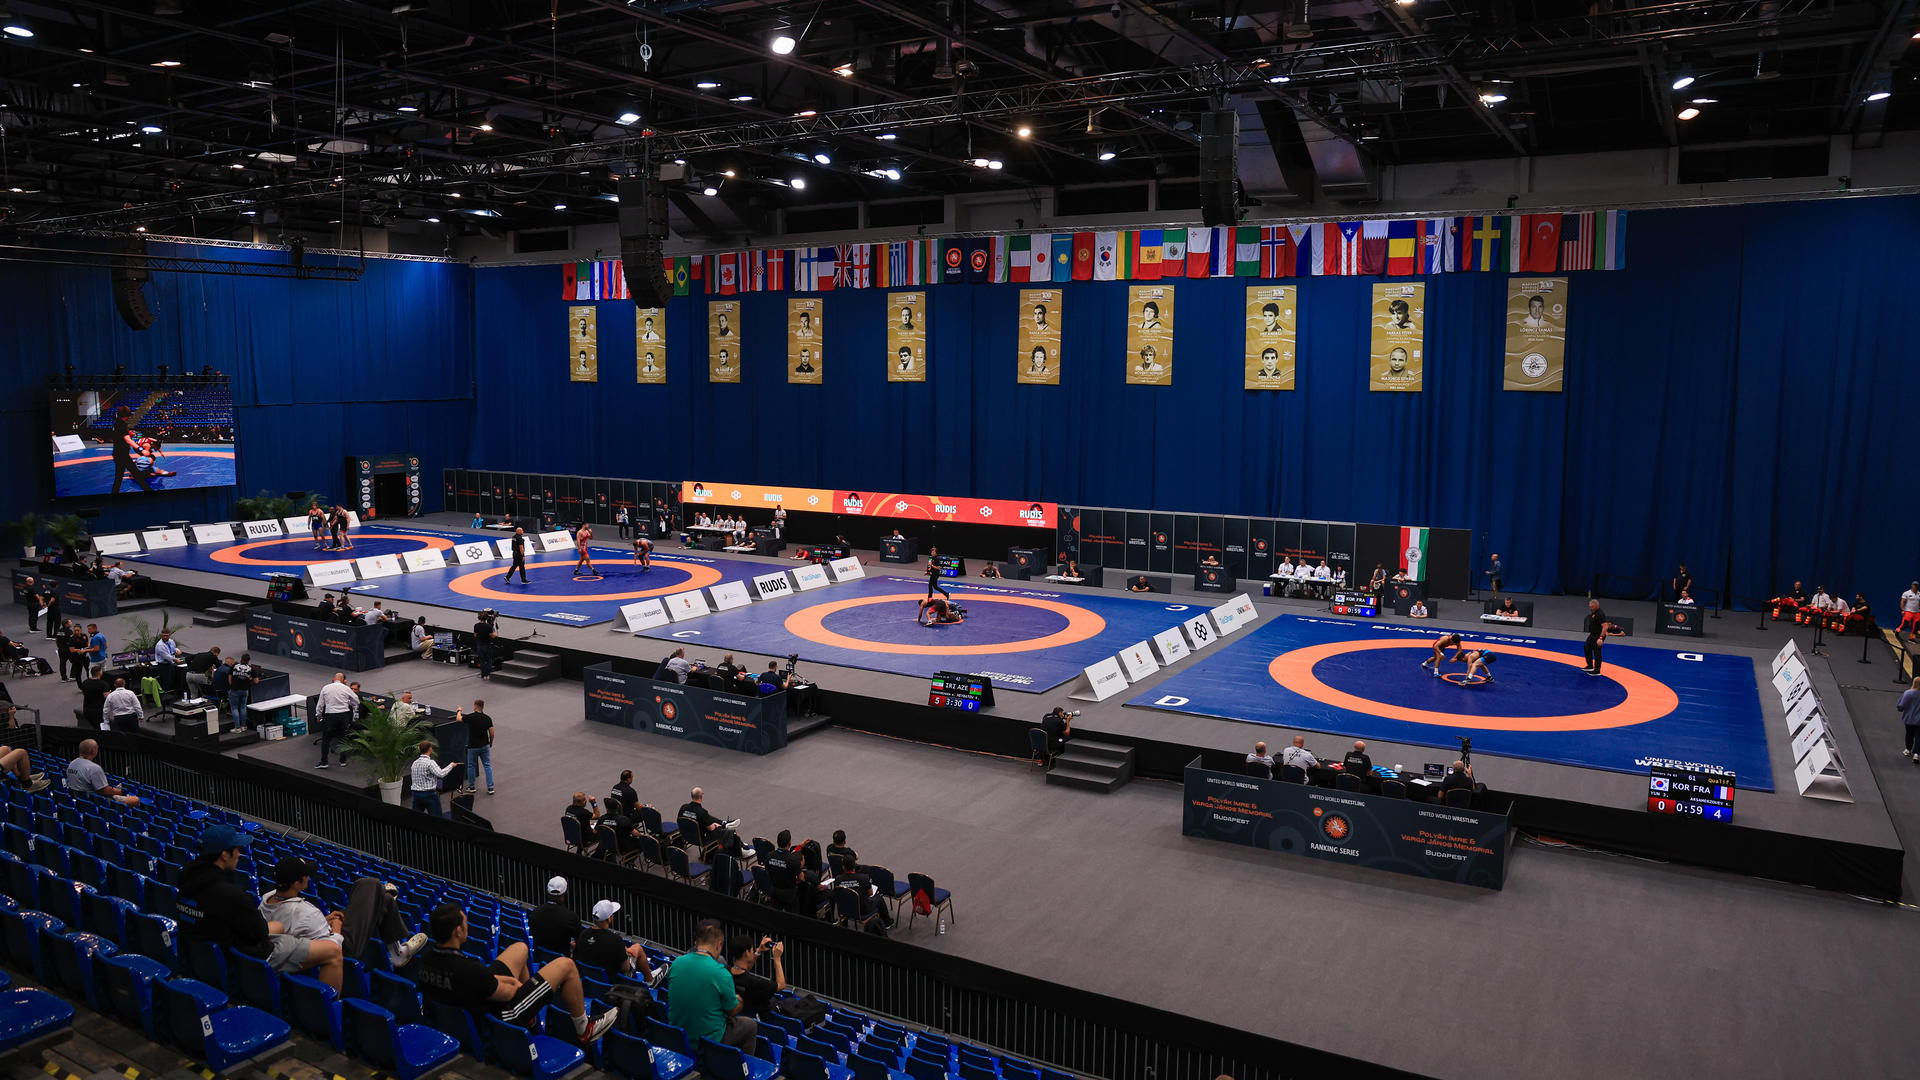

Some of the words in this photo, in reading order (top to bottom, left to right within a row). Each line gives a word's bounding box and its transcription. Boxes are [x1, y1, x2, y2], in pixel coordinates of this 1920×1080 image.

[764, 494, 783, 502] RUDIS
[844, 498, 863, 508] RUDIS
[935, 504, 957, 514] RUDIS
[1020, 509, 1043, 519] RUDIS
[249, 523, 277, 535] RUDIS
[760, 577, 787, 594] RUDIS
[1484, 635, 1537, 644] 2025
[1677, 653, 1703, 662] D
[945, 698, 963, 707] 3:30
[968, 702, 973, 710] 0
[1154, 695, 1190, 707] D
[655, 722, 671, 731] RANKING
[672, 724, 684, 733] SERIES
[1634, 759, 1736, 777] WRESTLING
[1644, 756, 1682, 765] UNITED
[1684, 761, 1724, 770] WORLD
[1207, 777, 1221, 785] UNITED
[1221, 779, 1236, 787] WORLD
[1236, 782, 1259, 790] WRESTLING
[1688, 774, 1696, 782] 61
[1708, 778, 1732, 786] Qualif.
[1672, 782, 1690, 791] KOR
[1693, 785, 1711, 794] FRA
[1309, 793, 1324, 801] UNITED
[1325, 795, 1340, 803] WORLD
[1341, 798, 1365, 807] WRESTLING
[1658, 801, 1665, 810] 0
[1676, 803, 1703, 814] 0:59
[1714, 809, 1721, 818] 4
[1213, 813, 1250, 824] BUDAPEST
[1419, 810, 1434, 818] UNITED
[1435, 812, 1451, 820] WORLD
[1452, 815, 1479, 824] WRESTLING
[1311, 842, 1338, 854] RANKING
[1340, 845, 1360, 857] SERIES
[1425, 849, 1467, 861] BUDAPEST
[204, 1020, 210, 1030] 6
